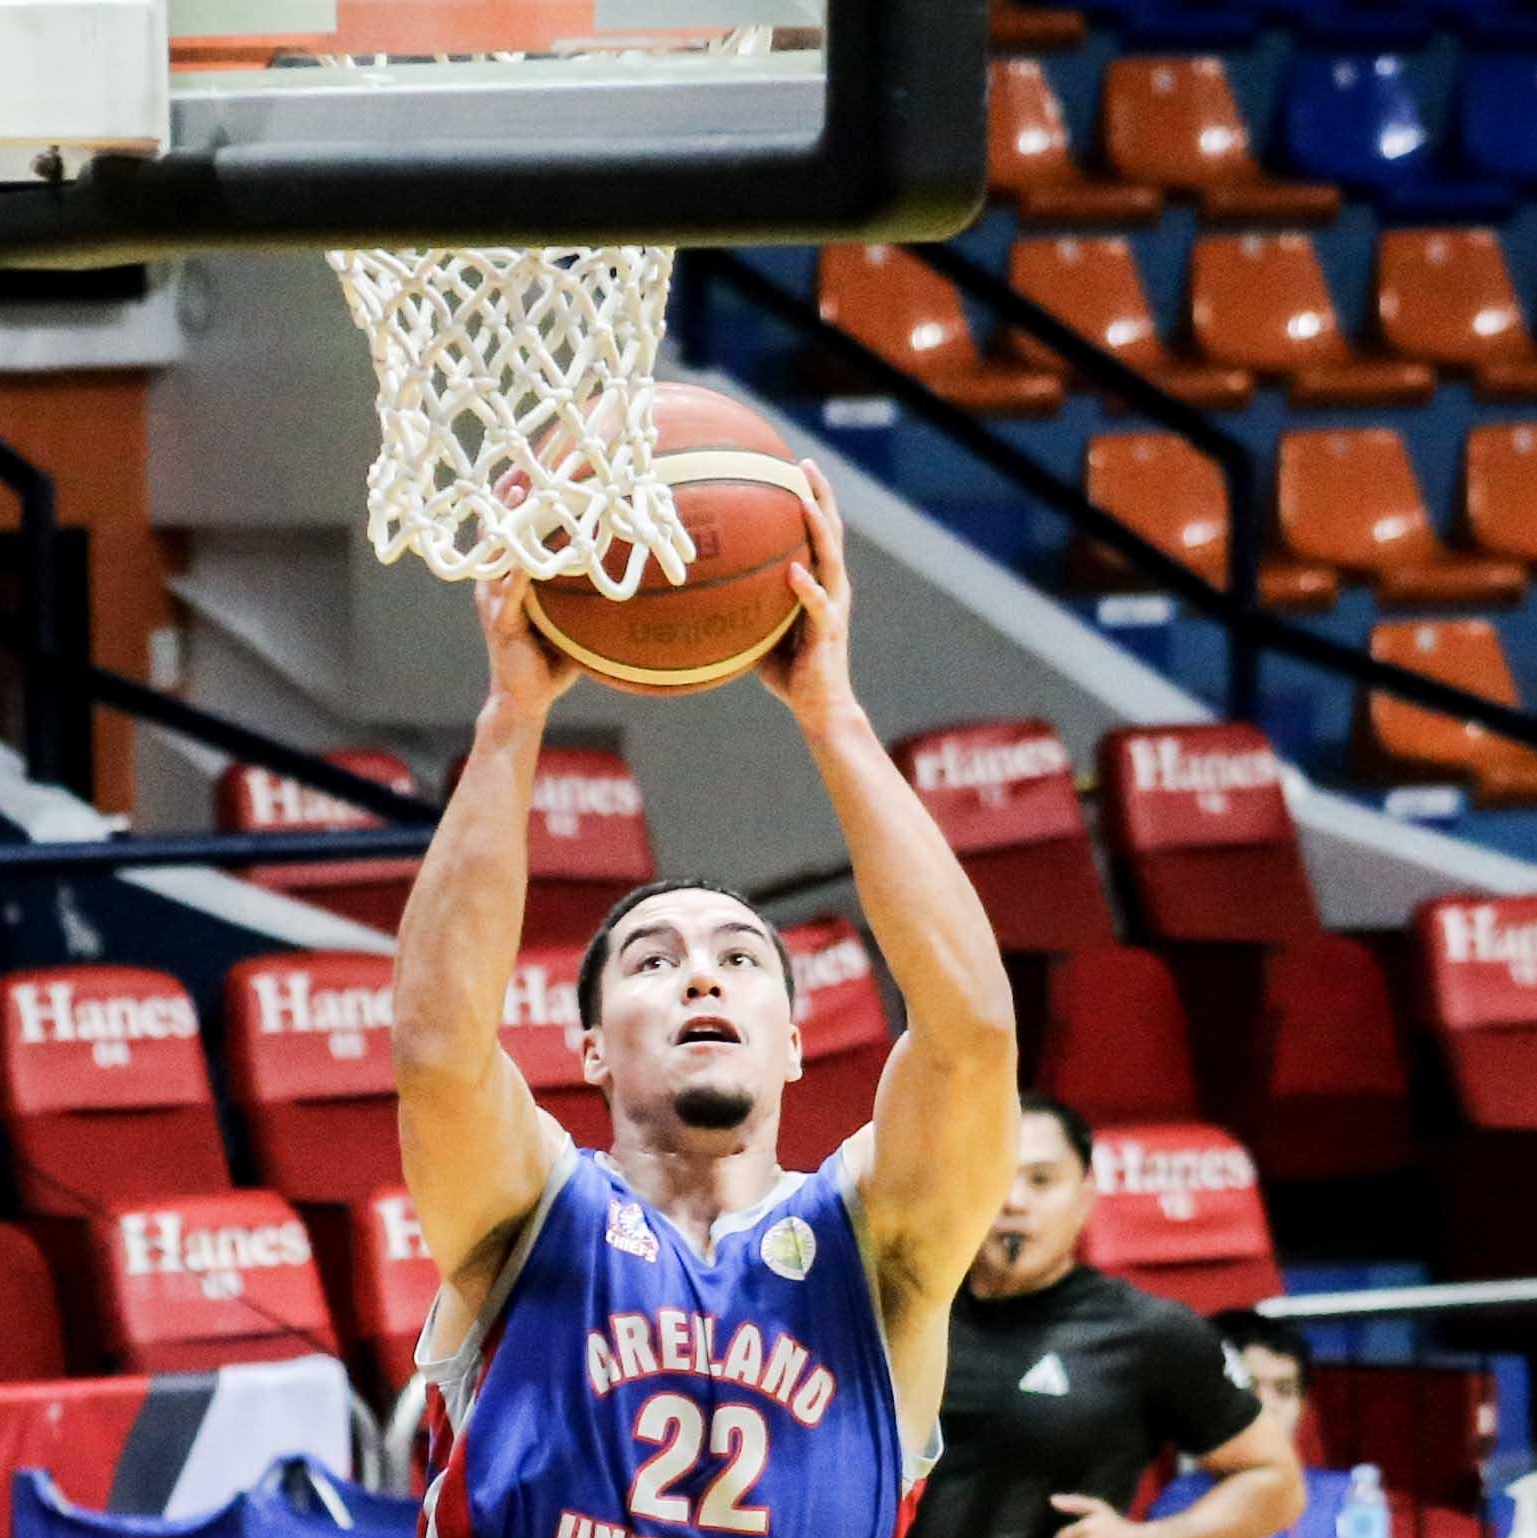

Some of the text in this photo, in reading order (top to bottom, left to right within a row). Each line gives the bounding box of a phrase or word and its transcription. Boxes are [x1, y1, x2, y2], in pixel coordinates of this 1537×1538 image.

[10, 982, 200, 1044] Hanes
[250, 970, 397, 1034] Hane
[1091, 1140, 1257, 1196] Hanes
[118, 1209, 312, 1277] Hanes
[628, 1391, 771, 1536] 22
